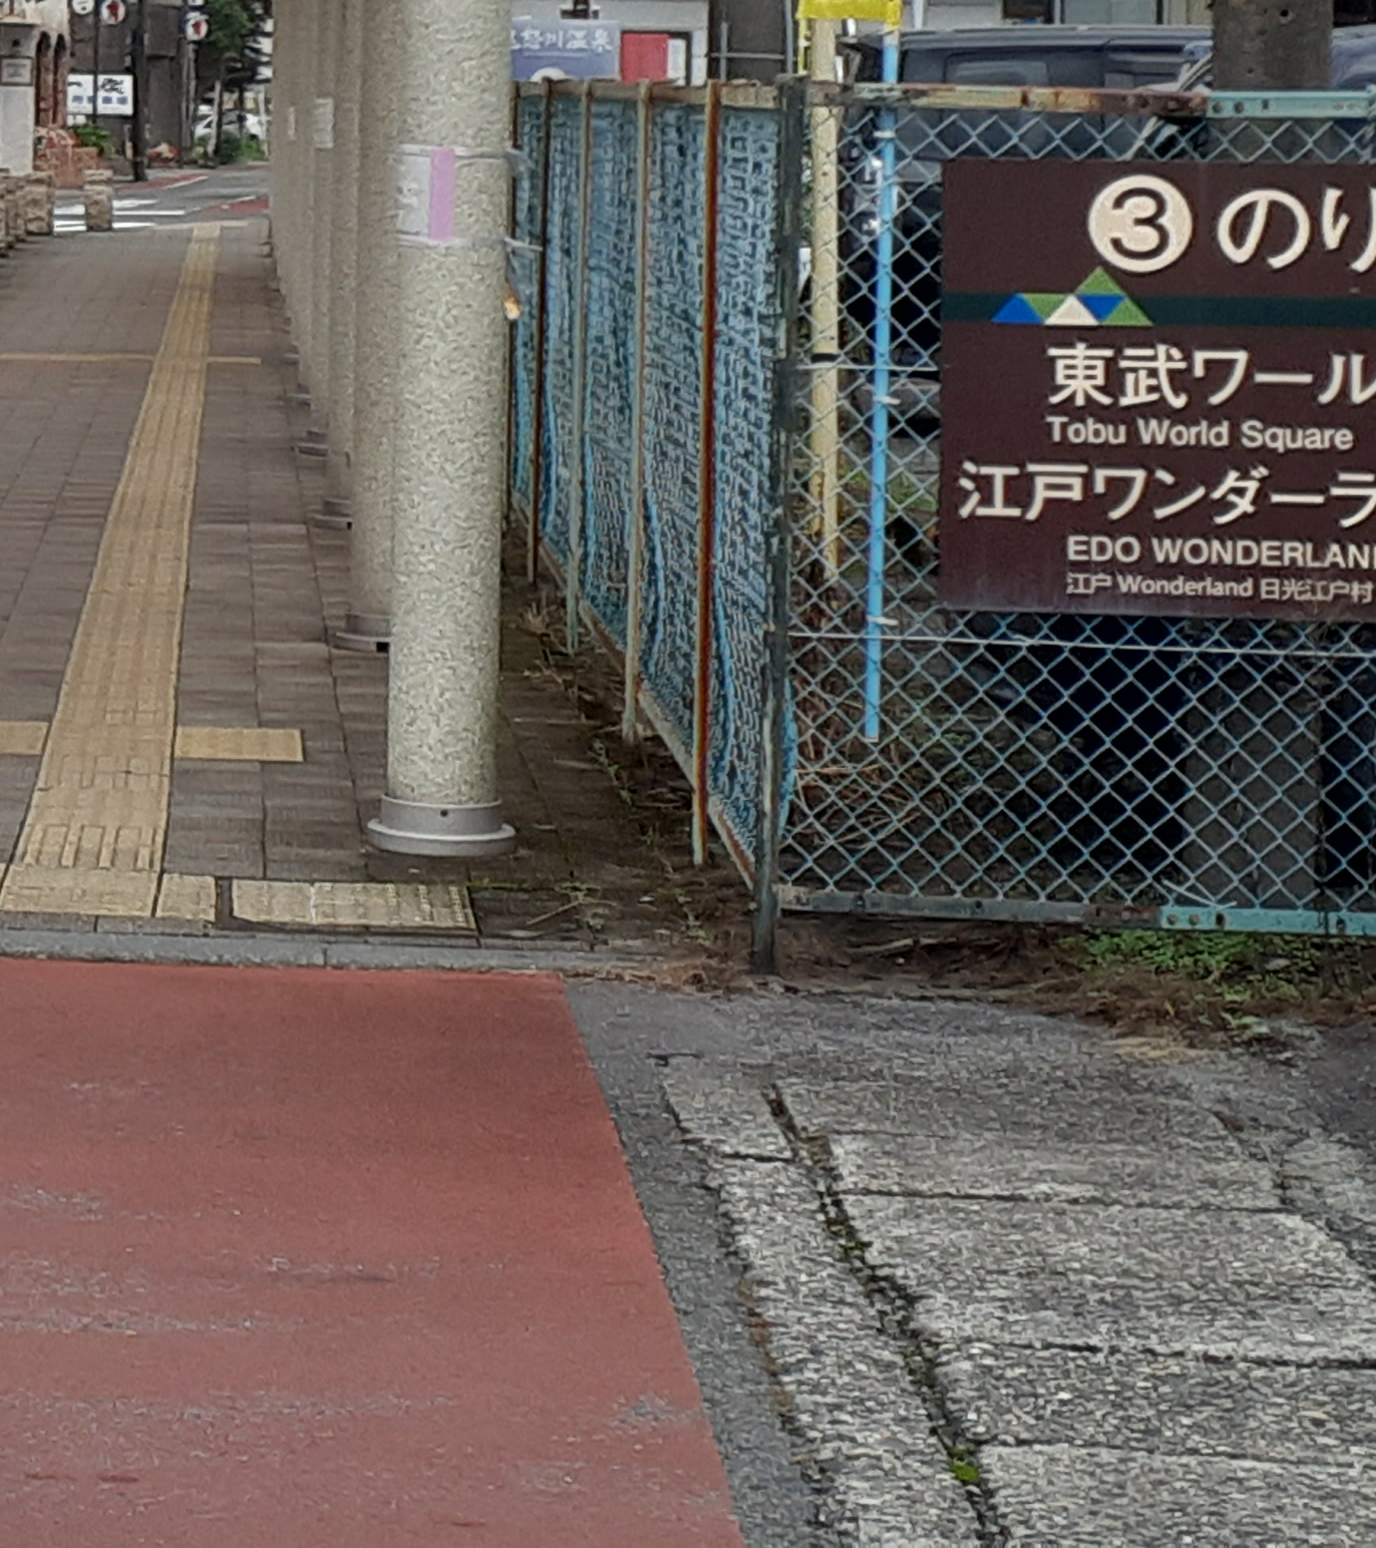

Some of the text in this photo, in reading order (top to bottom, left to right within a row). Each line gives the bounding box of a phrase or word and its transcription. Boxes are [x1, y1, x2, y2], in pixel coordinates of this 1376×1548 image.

[1046, 342, 1376, 409] 東武ワール
[1045, 416, 1355, 454] Tobu World Square
[958, 460, 1376, 529] 江戸ワンダーラ
[1066, 534, 1376, 570] EDO WONDERLAN
[1117, 574, 1254, 599] Wonderland
